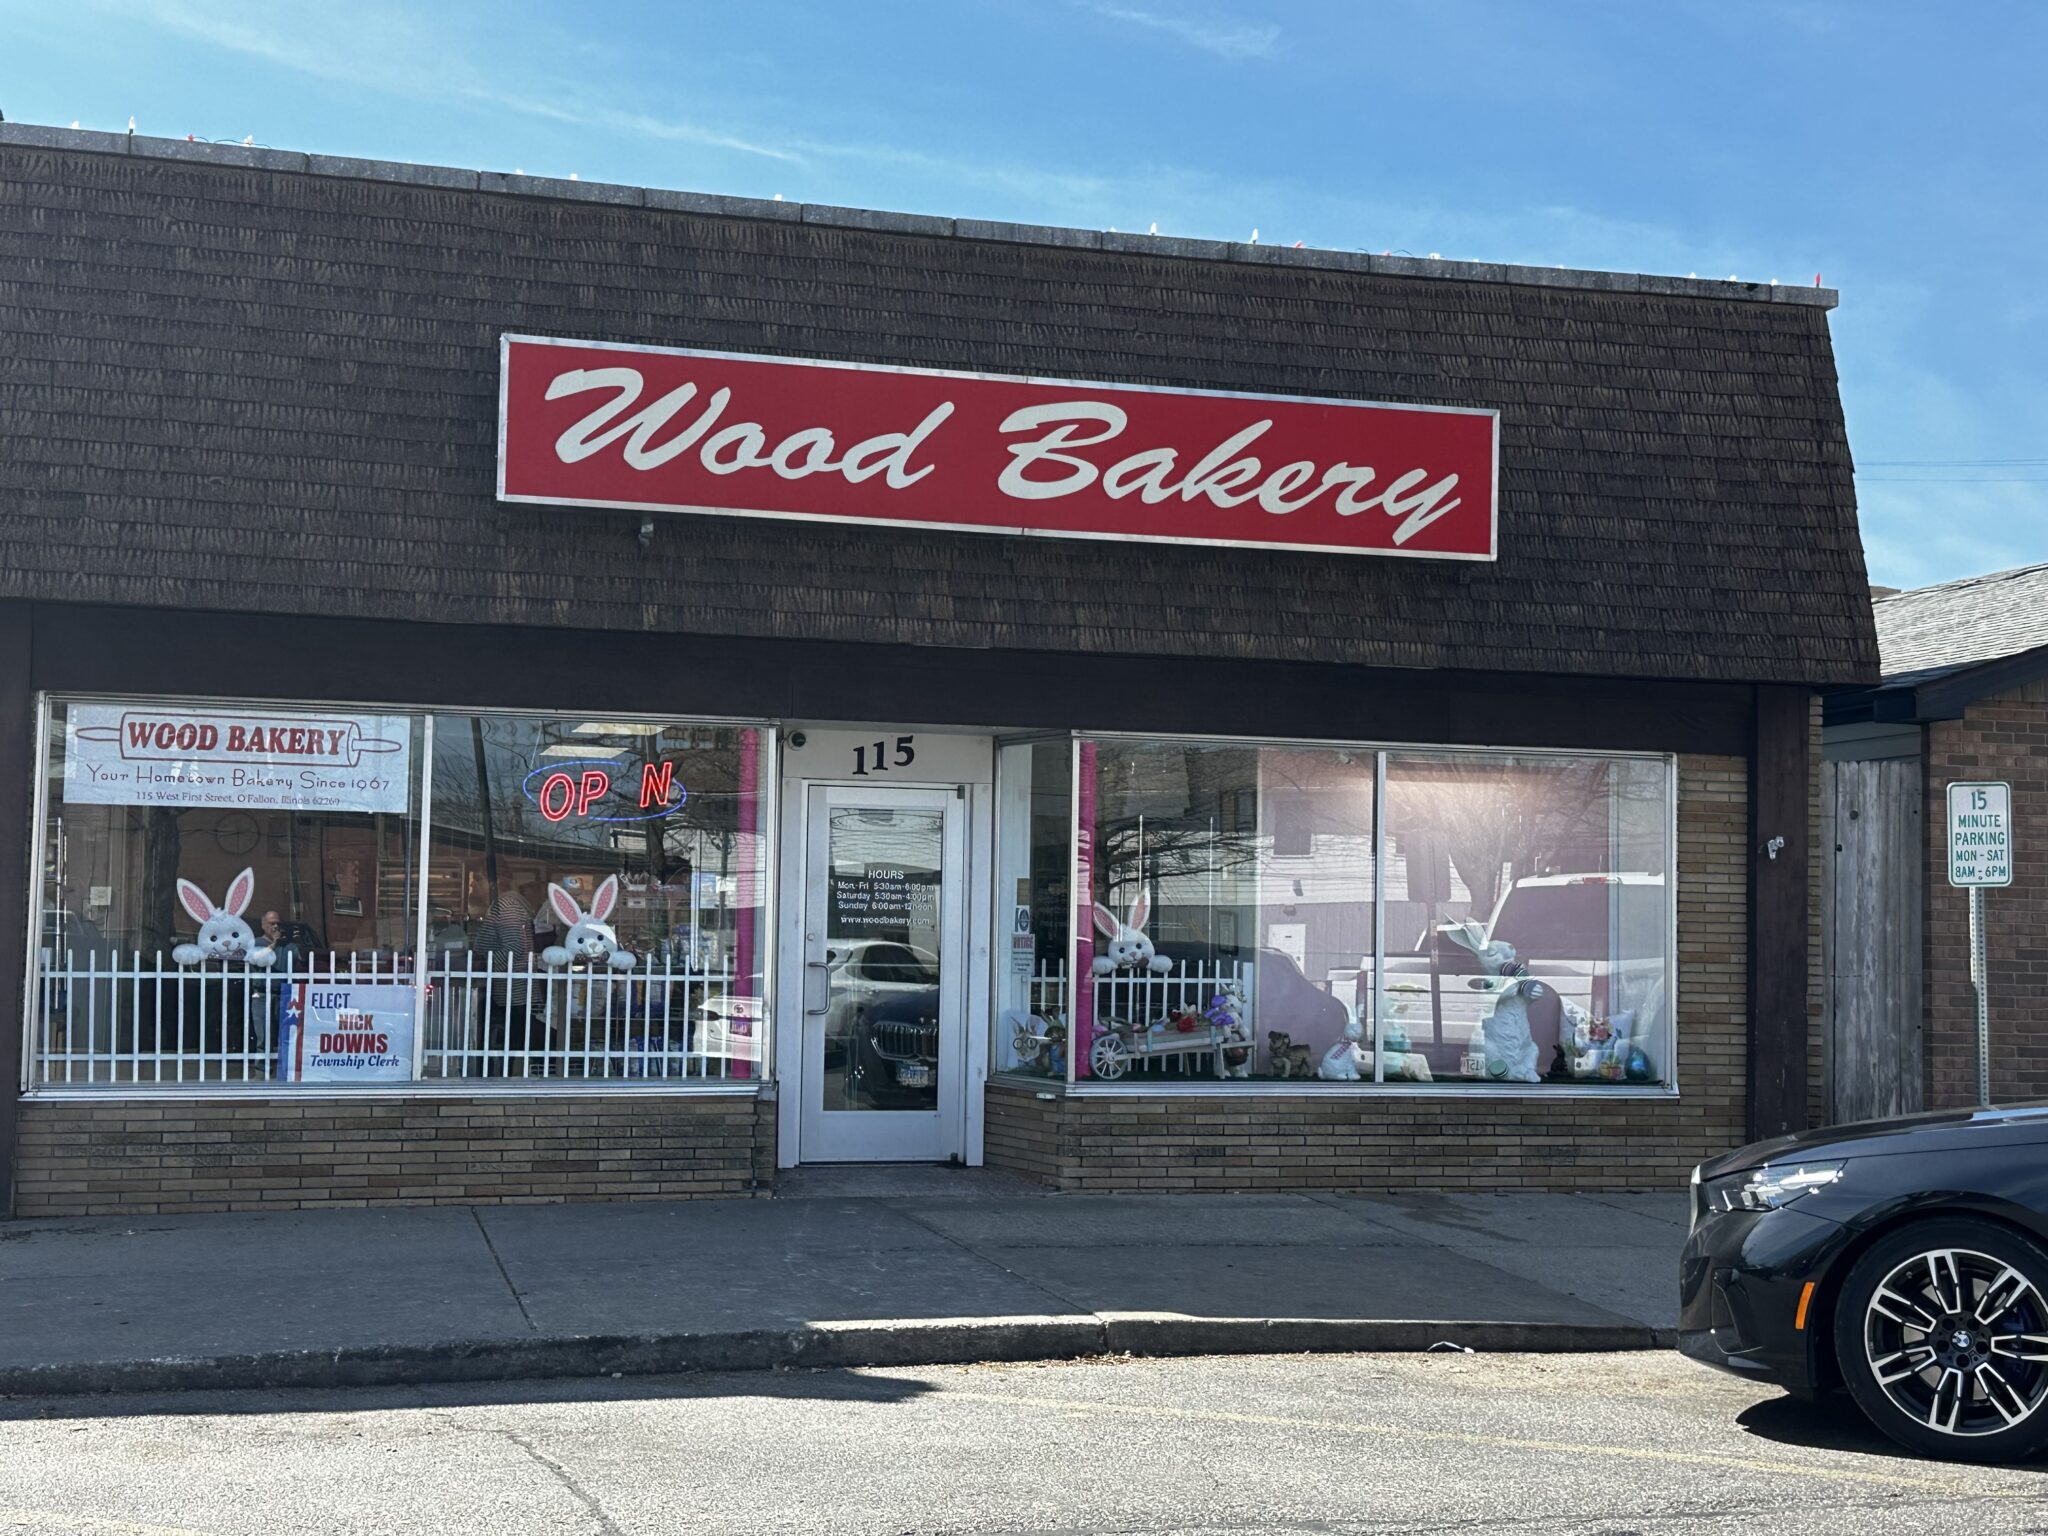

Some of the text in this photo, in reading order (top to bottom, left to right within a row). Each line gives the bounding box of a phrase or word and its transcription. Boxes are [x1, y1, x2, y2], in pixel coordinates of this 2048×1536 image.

[545, 367, 1461, 546] Wood Bakery
[128, 721, 346, 755] WOOD BAKERY
[852, 735, 915, 775] 115
[86, 764, 390, 791] Your Hometown Bakery Since 1967
[137, 791, 153, 800] 115
[156, 791, 179, 801] West
[182, 792, 202, 802] First
[540, 761, 673, 822] OPN
[1971, 790, 1987, 810] 15
[1958, 814, 2001, 828] MINUTE
[1955, 831, 2005, 846] PARKING
[1956, 850, 1977, 862] MON
[1987, 849, 2005, 861] SAT
[868, 869, 905, 880] HOURS
[836, 890, 871, 901] Saturday
[838, 900, 868, 911] Sunday
[311, 992, 350, 1009] ELECT
[338, 1013, 374, 1031] NICK
[319, 1033, 389, 1054] DOWNS
[310, 1055, 400, 1070] Township Clerk
